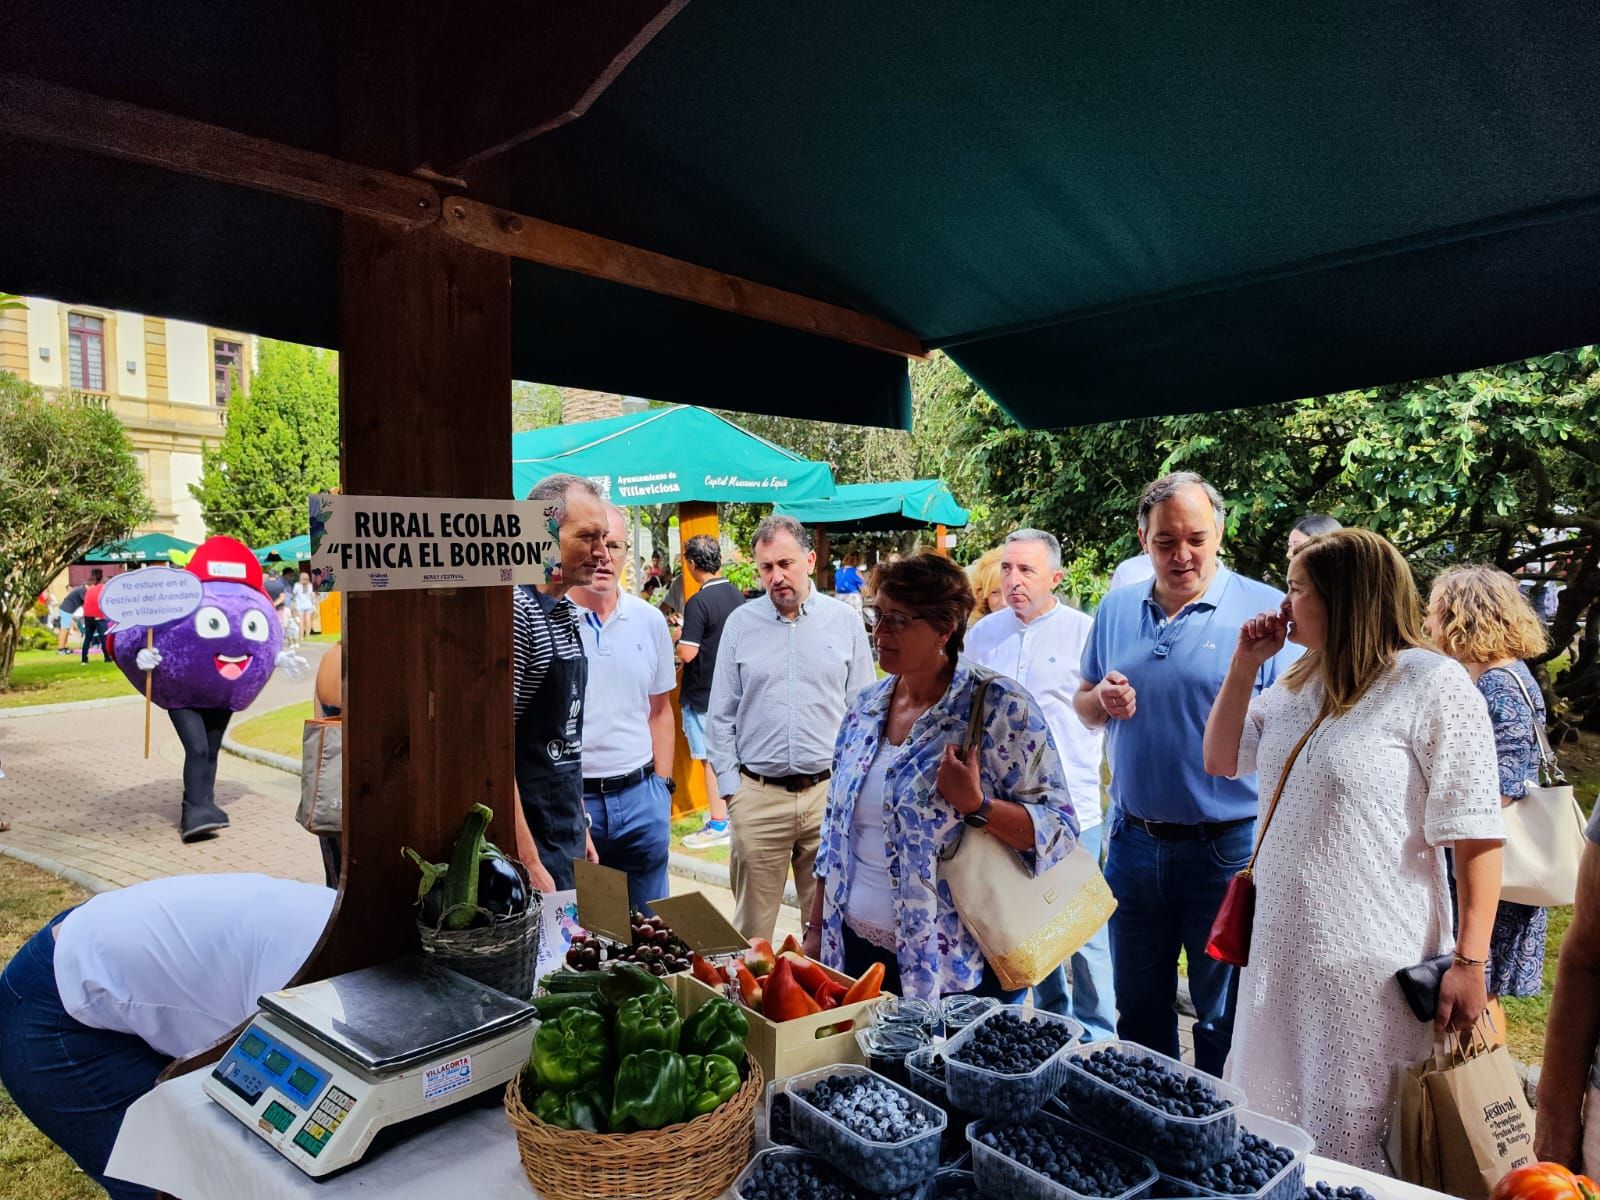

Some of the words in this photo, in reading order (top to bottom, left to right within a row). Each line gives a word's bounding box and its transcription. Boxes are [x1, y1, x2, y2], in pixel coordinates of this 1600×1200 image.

[617, 472, 668, 485] Ayuntamiento
[668, 471, 677, 480] de
[618, 483, 681, 497] Villaviciosa
[354, 511, 434, 538] RURAL
[440, 512, 521, 538] ECOLAB
[419, 542, 445, 568] EL
[121, 582, 133, 590] Yo
[134, 581, 164, 590] estuve
[166, 580, 178, 588] en
[179, 578, 188, 586] el
[105, 593, 140, 605] Festival
[142, 592, 157, 602] del
[121, 609, 133, 617] en
[135, 606, 183, 616] Villaviciosa
[425, 1057, 469, 1078] VILLACORTA
[1483, 1096, 1516, 1122] Festival
